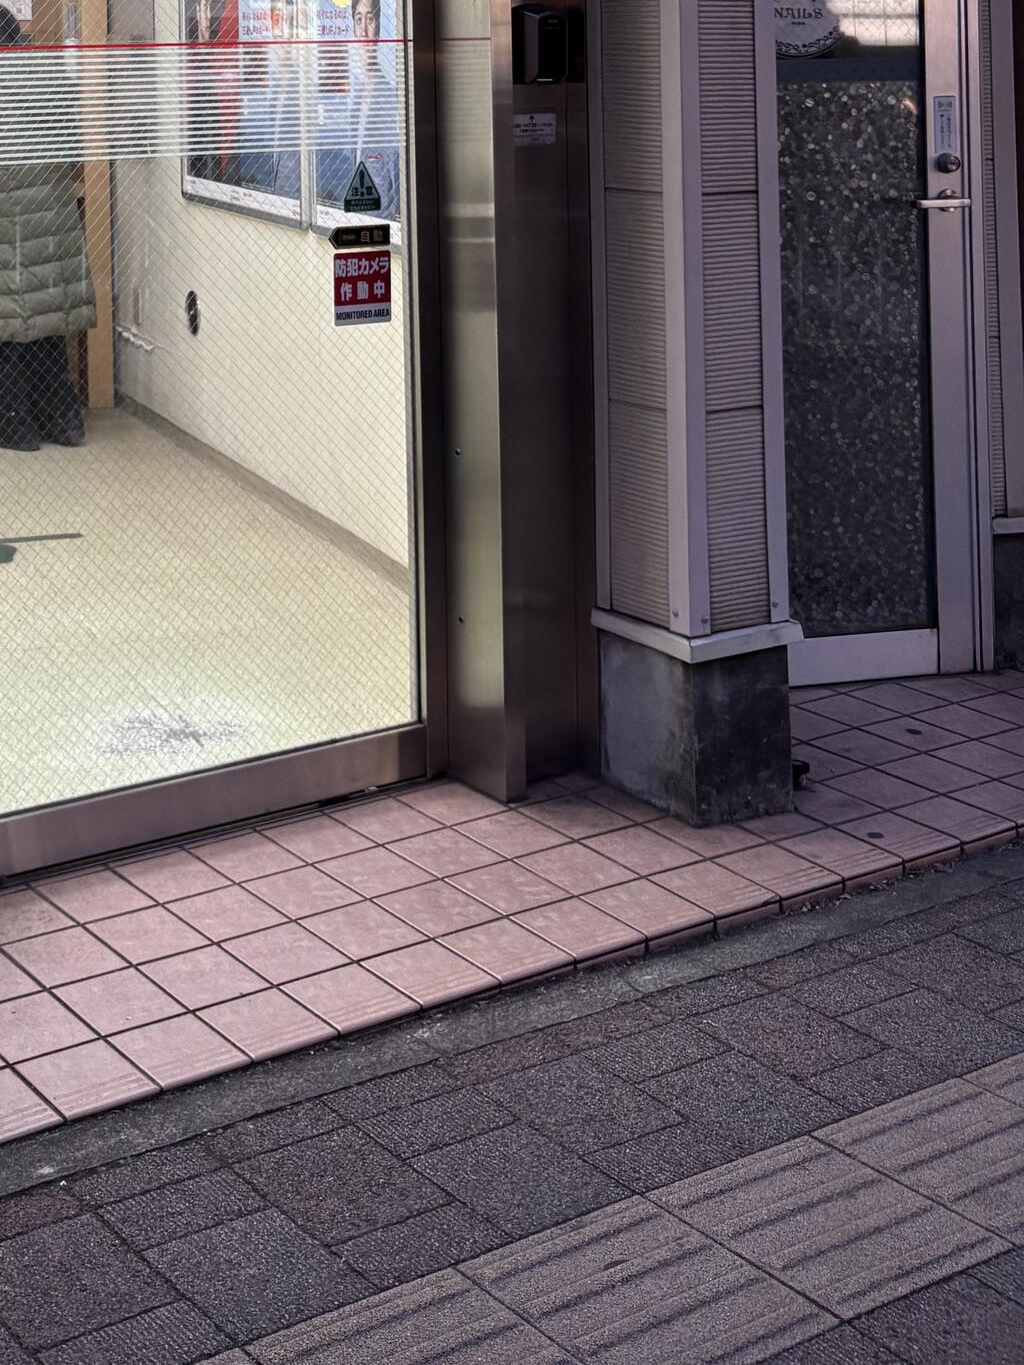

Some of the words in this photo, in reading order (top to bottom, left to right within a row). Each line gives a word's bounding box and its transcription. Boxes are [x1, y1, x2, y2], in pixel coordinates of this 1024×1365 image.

[335, 257, 390, 278] 防犯カメラ
[340, 280, 386, 301] 作動中
[336, 309, 373, 322] MONITORED
[373, 307, 390, 318] AREA
